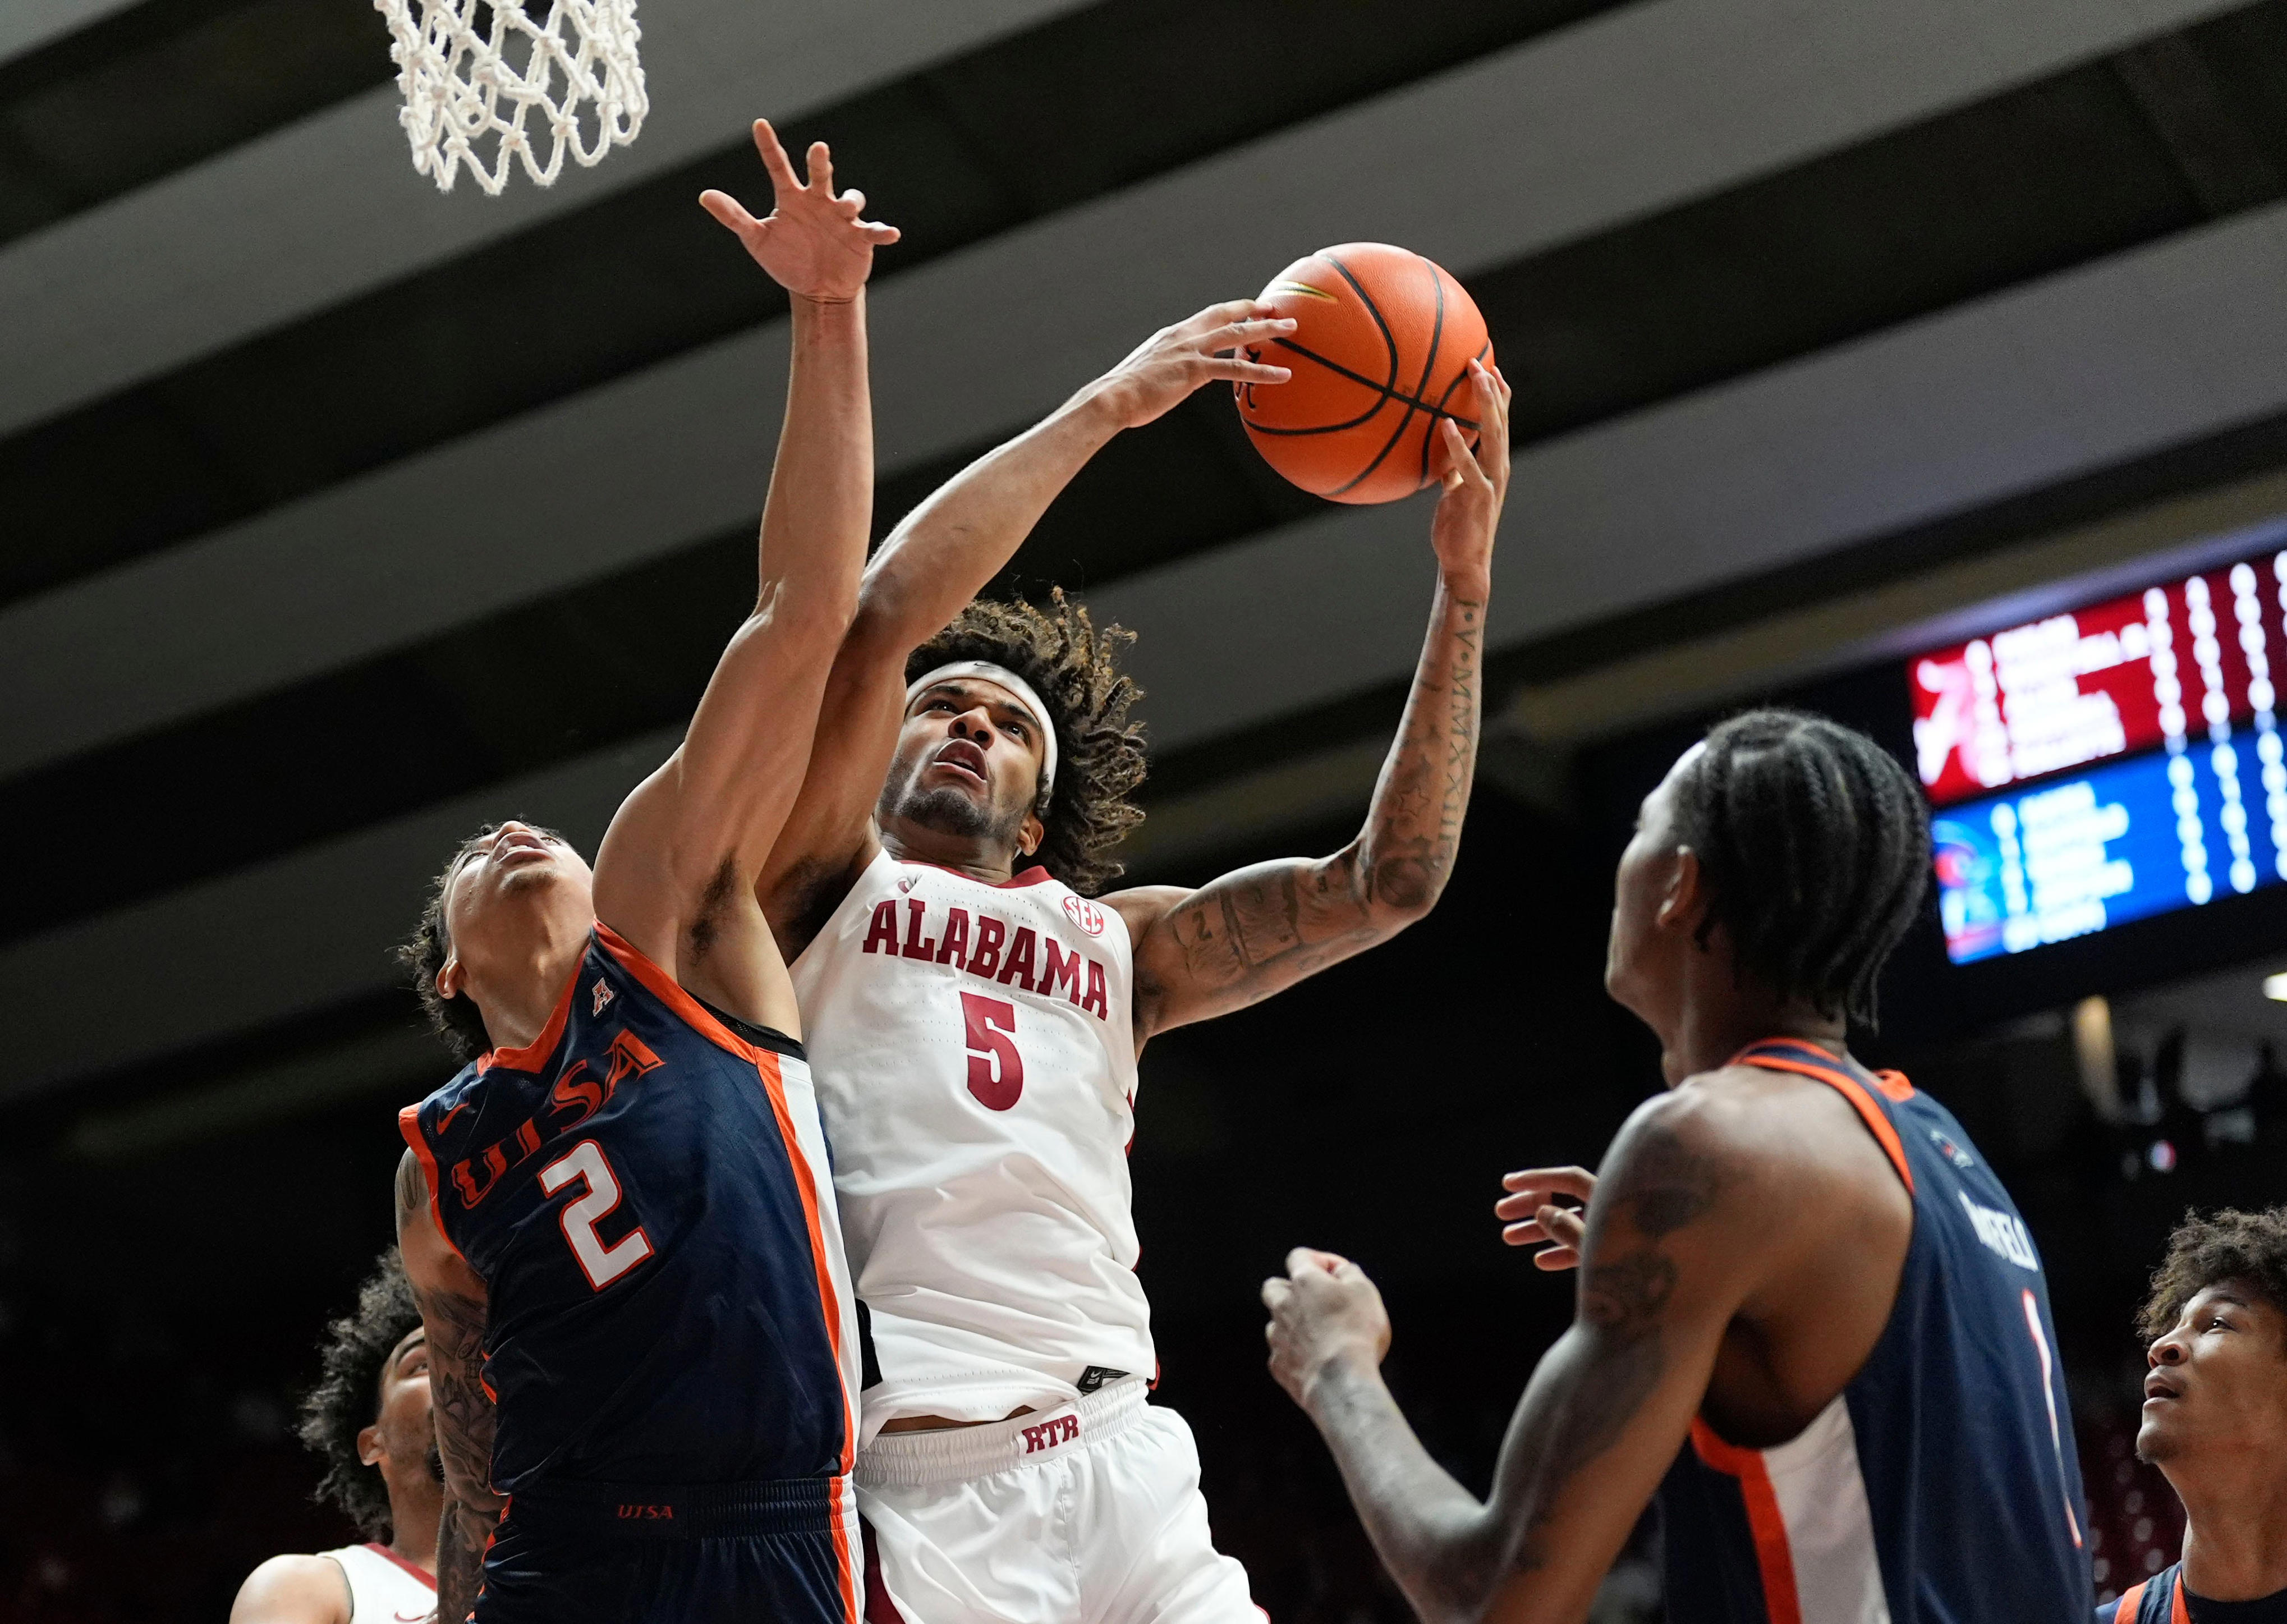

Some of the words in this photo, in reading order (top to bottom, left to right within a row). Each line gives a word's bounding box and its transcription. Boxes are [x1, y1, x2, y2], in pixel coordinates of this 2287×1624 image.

[862, 898, 1108, 1021] ALABAMA
[1065, 898, 1103, 933] SEC
[959, 991, 1023, 1111] 5
[451, 1028, 667, 1210] UTSA
[537, 1138, 655, 1291] 2
[1021, 1414, 1080, 1454] RTR
[618, 1504, 673, 1519] UTSA
